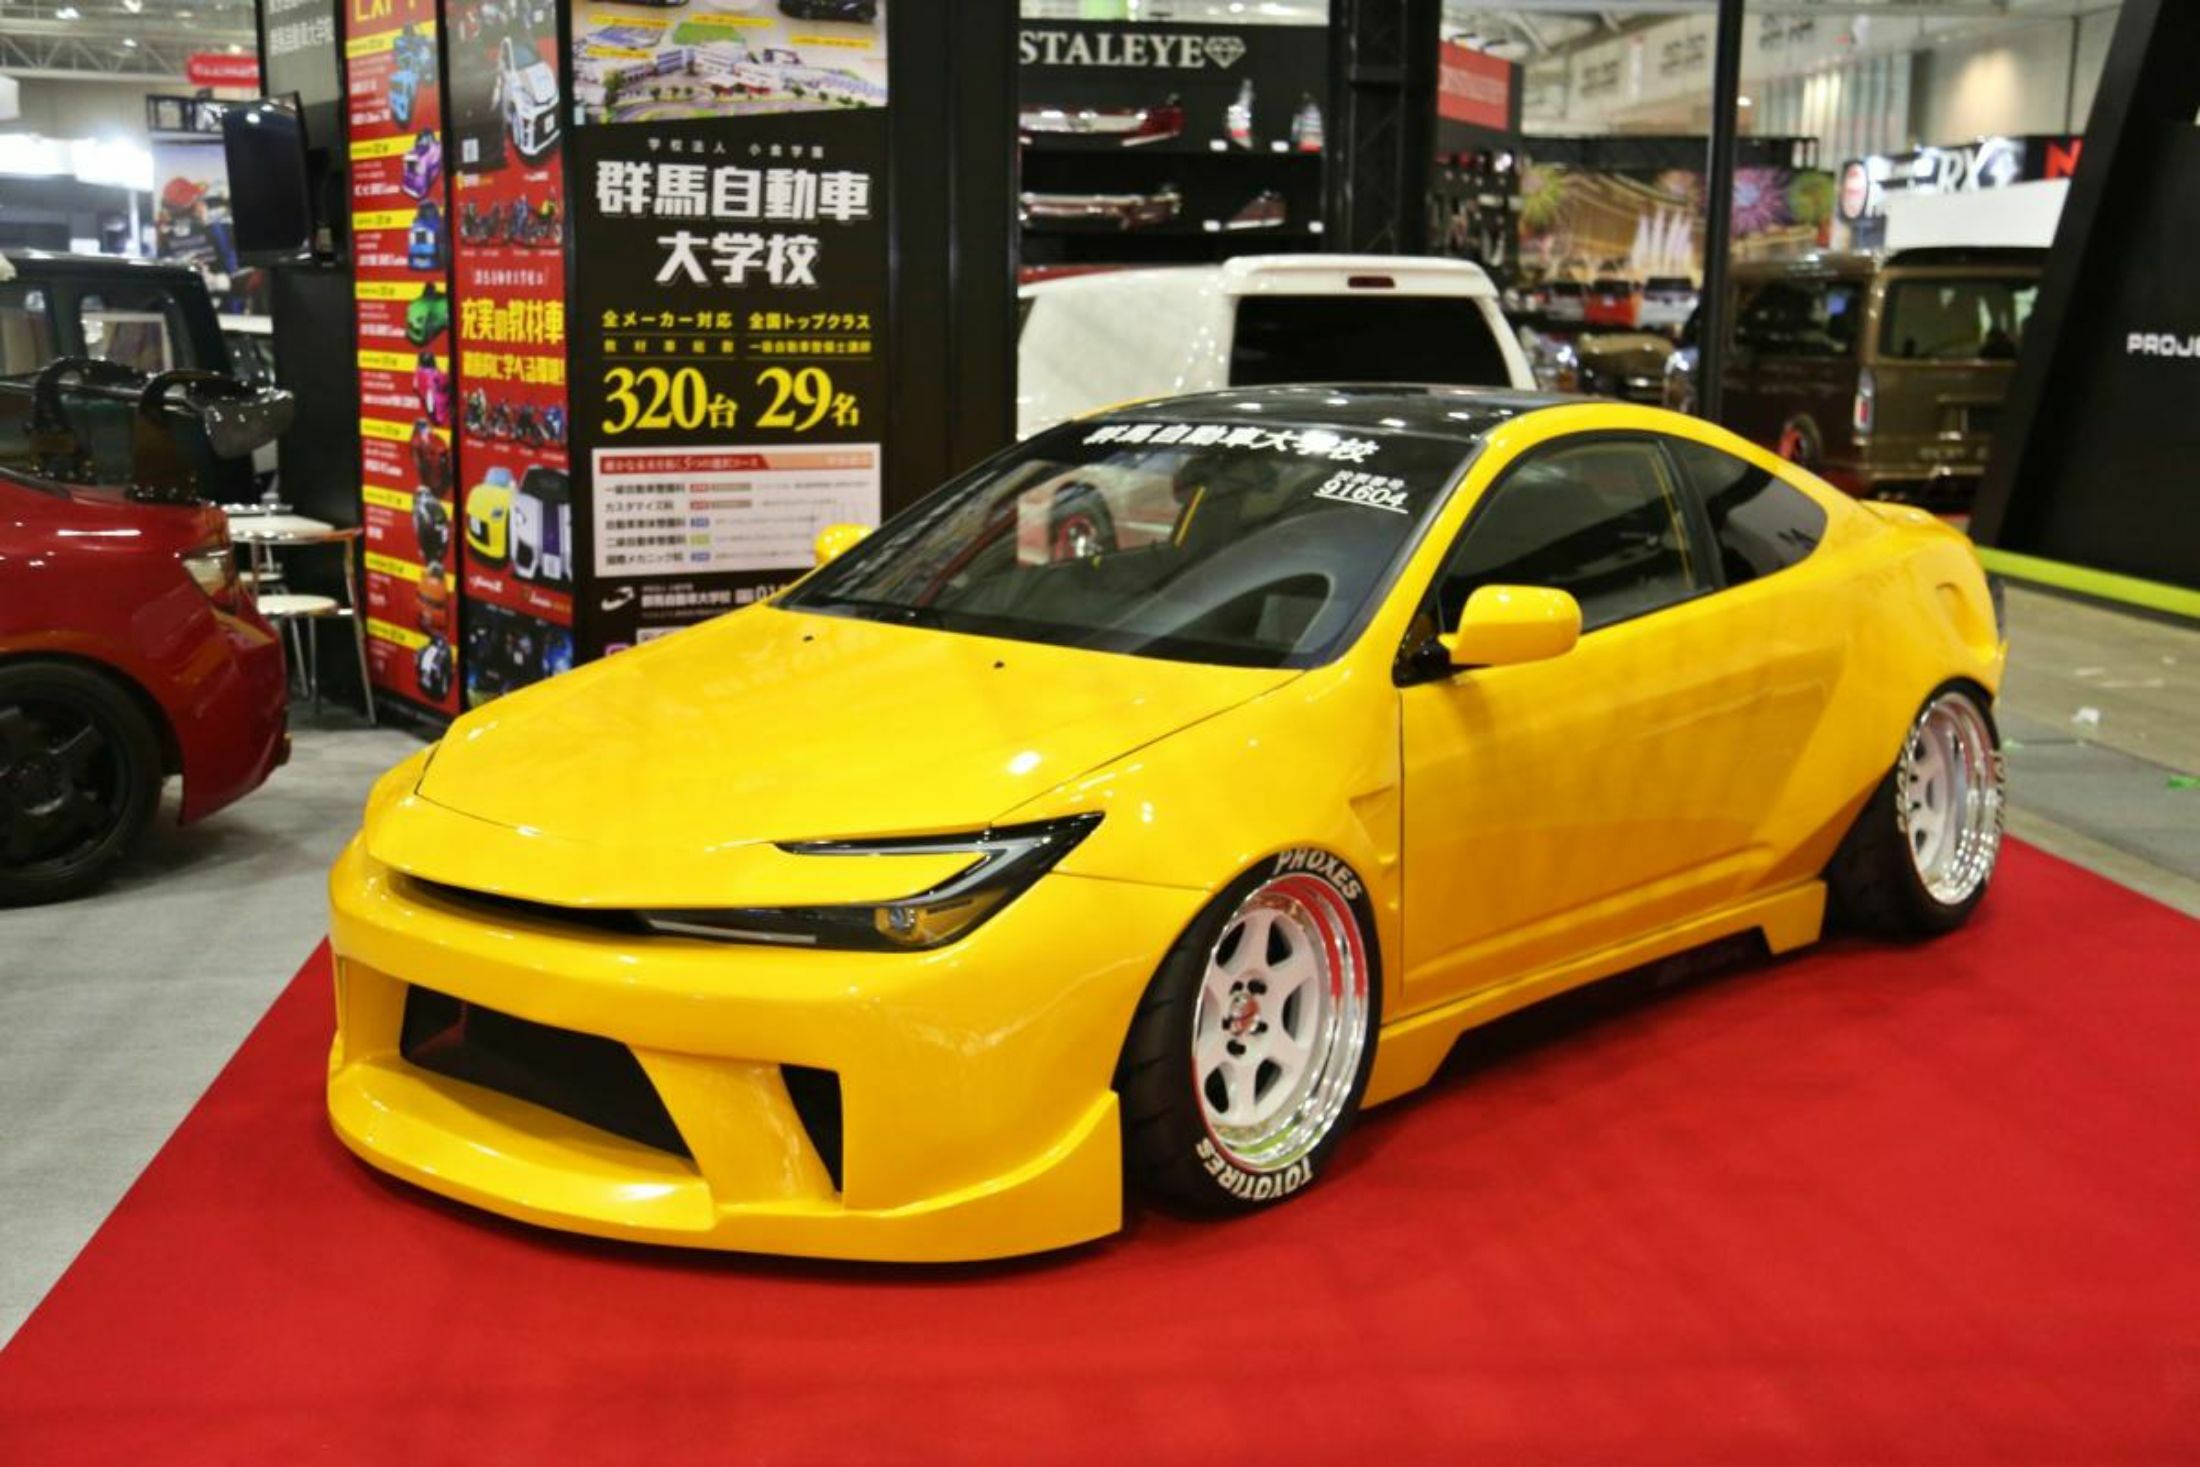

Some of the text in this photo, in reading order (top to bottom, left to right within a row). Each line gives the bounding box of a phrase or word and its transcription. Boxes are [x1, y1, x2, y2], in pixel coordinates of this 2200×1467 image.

[1019, 30, 1205, 68] STALEYE
[596, 160, 870, 221] 群馬自動車
[655, 231, 819, 286] 大学校
[602, 310, 871, 330] 全メーカー対応 全国トップクラス
[1318, 479, 1408, 508] 91604
